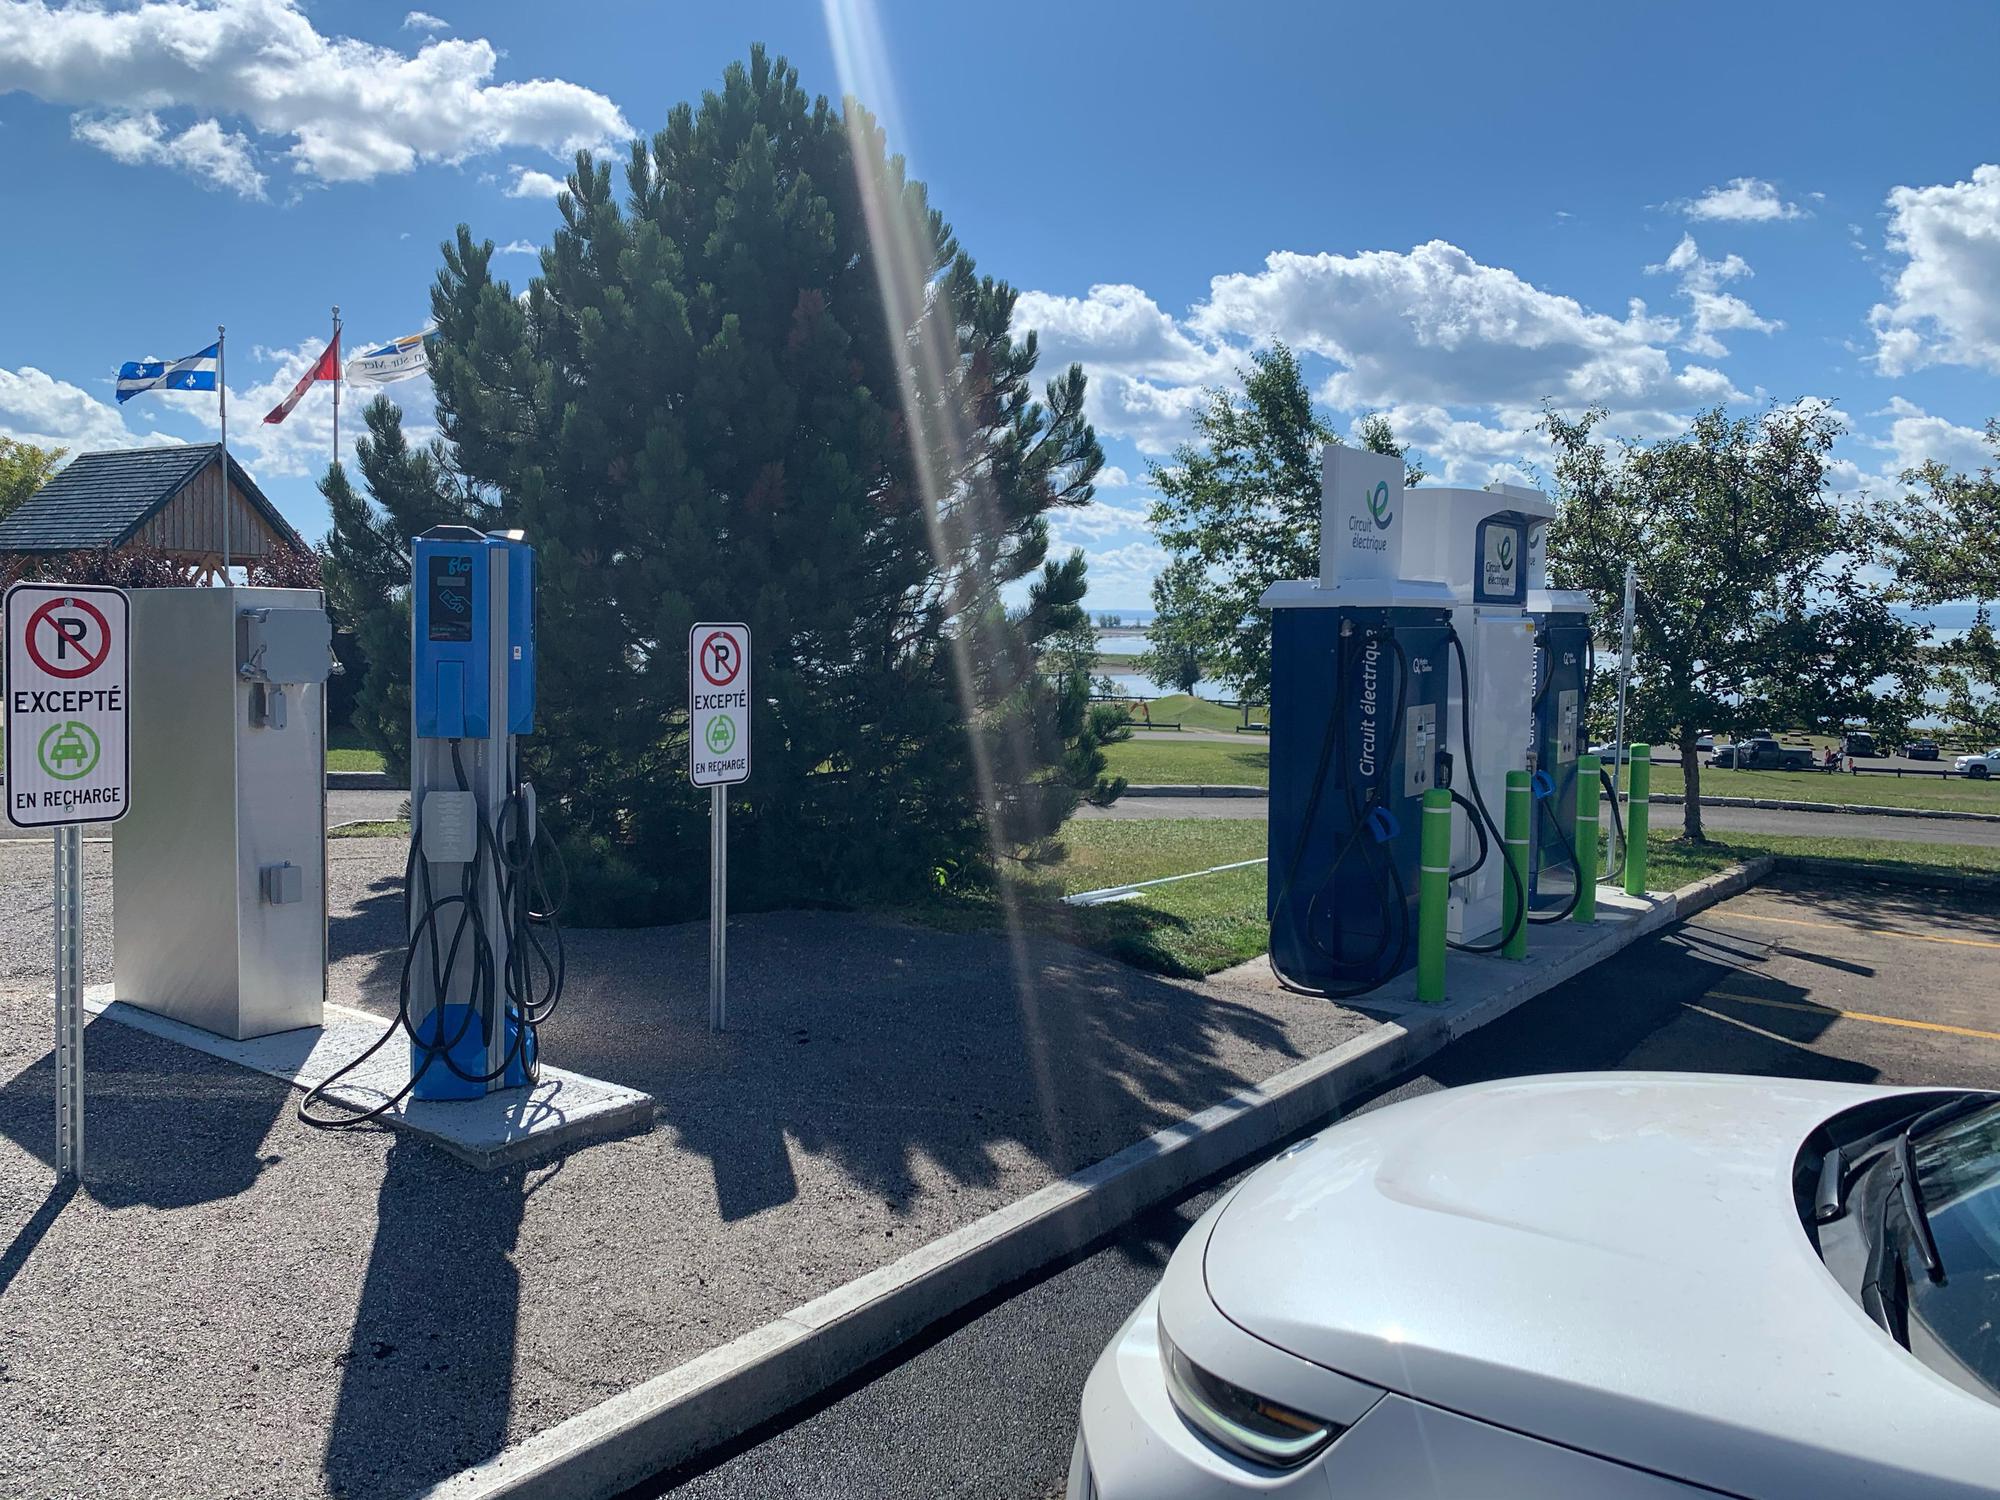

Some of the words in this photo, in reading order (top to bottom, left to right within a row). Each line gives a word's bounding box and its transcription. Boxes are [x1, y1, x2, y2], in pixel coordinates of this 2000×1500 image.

[1349, 516, 1372, 532] Circuit
[1352, 532, 1387, 553] électrique
[57, 618, 87, 659] P
[715, 645, 730, 673] P
[14, 685, 122, 713] EXCEPTÉ
[695, 690, 746, 709] EXCEPTÉ
[1359, 720, 1376, 777] Circuit
[695, 763, 706, 774] EN
[708, 758, 746, 773] RECHARGE
[17, 792, 36, 809] EN
[44, 787, 121, 807] RECHARGE
